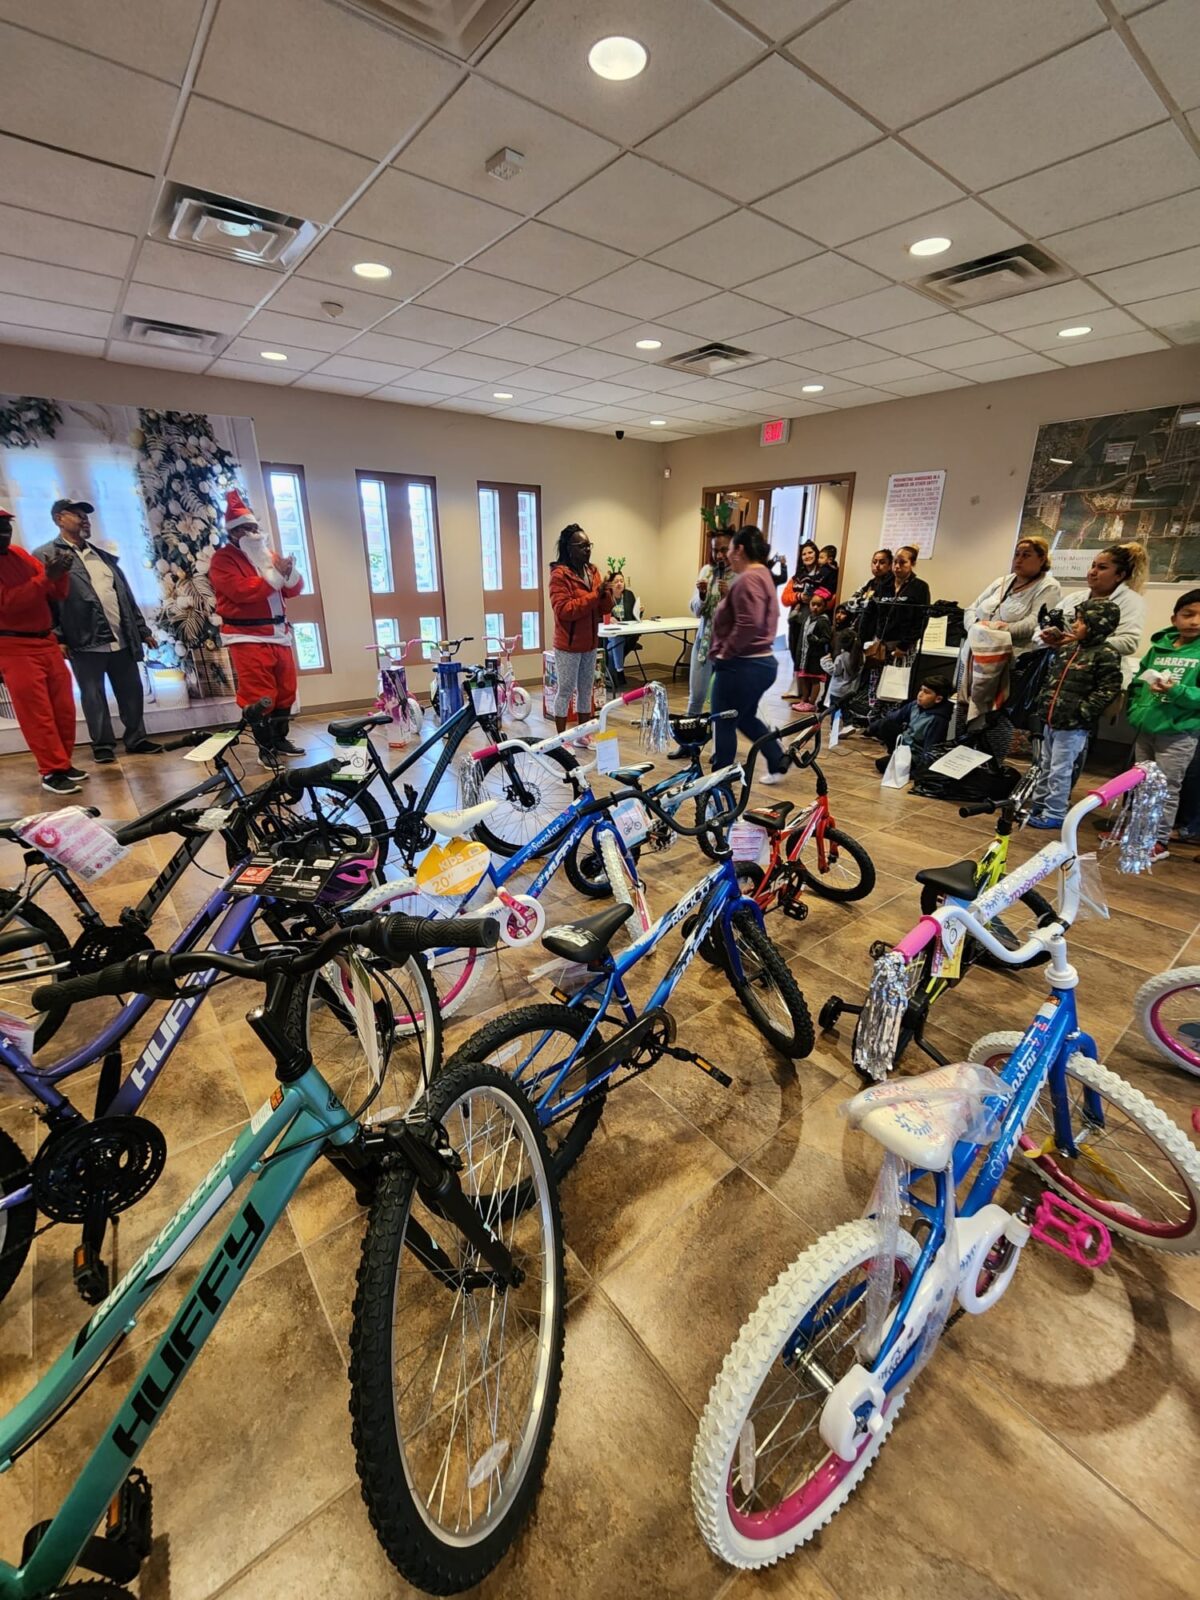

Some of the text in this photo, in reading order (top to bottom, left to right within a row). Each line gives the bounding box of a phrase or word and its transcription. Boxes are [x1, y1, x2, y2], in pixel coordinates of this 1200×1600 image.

[1153, 657, 1200, 668] GARRETT
[531, 823, 560, 851] Seastar
[147, 840, 195, 905] HUF
[439, 852, 464, 872] KIDS
[671, 895, 699, 926] ROCK
[112, 1202, 265, 1458] HUFFY
